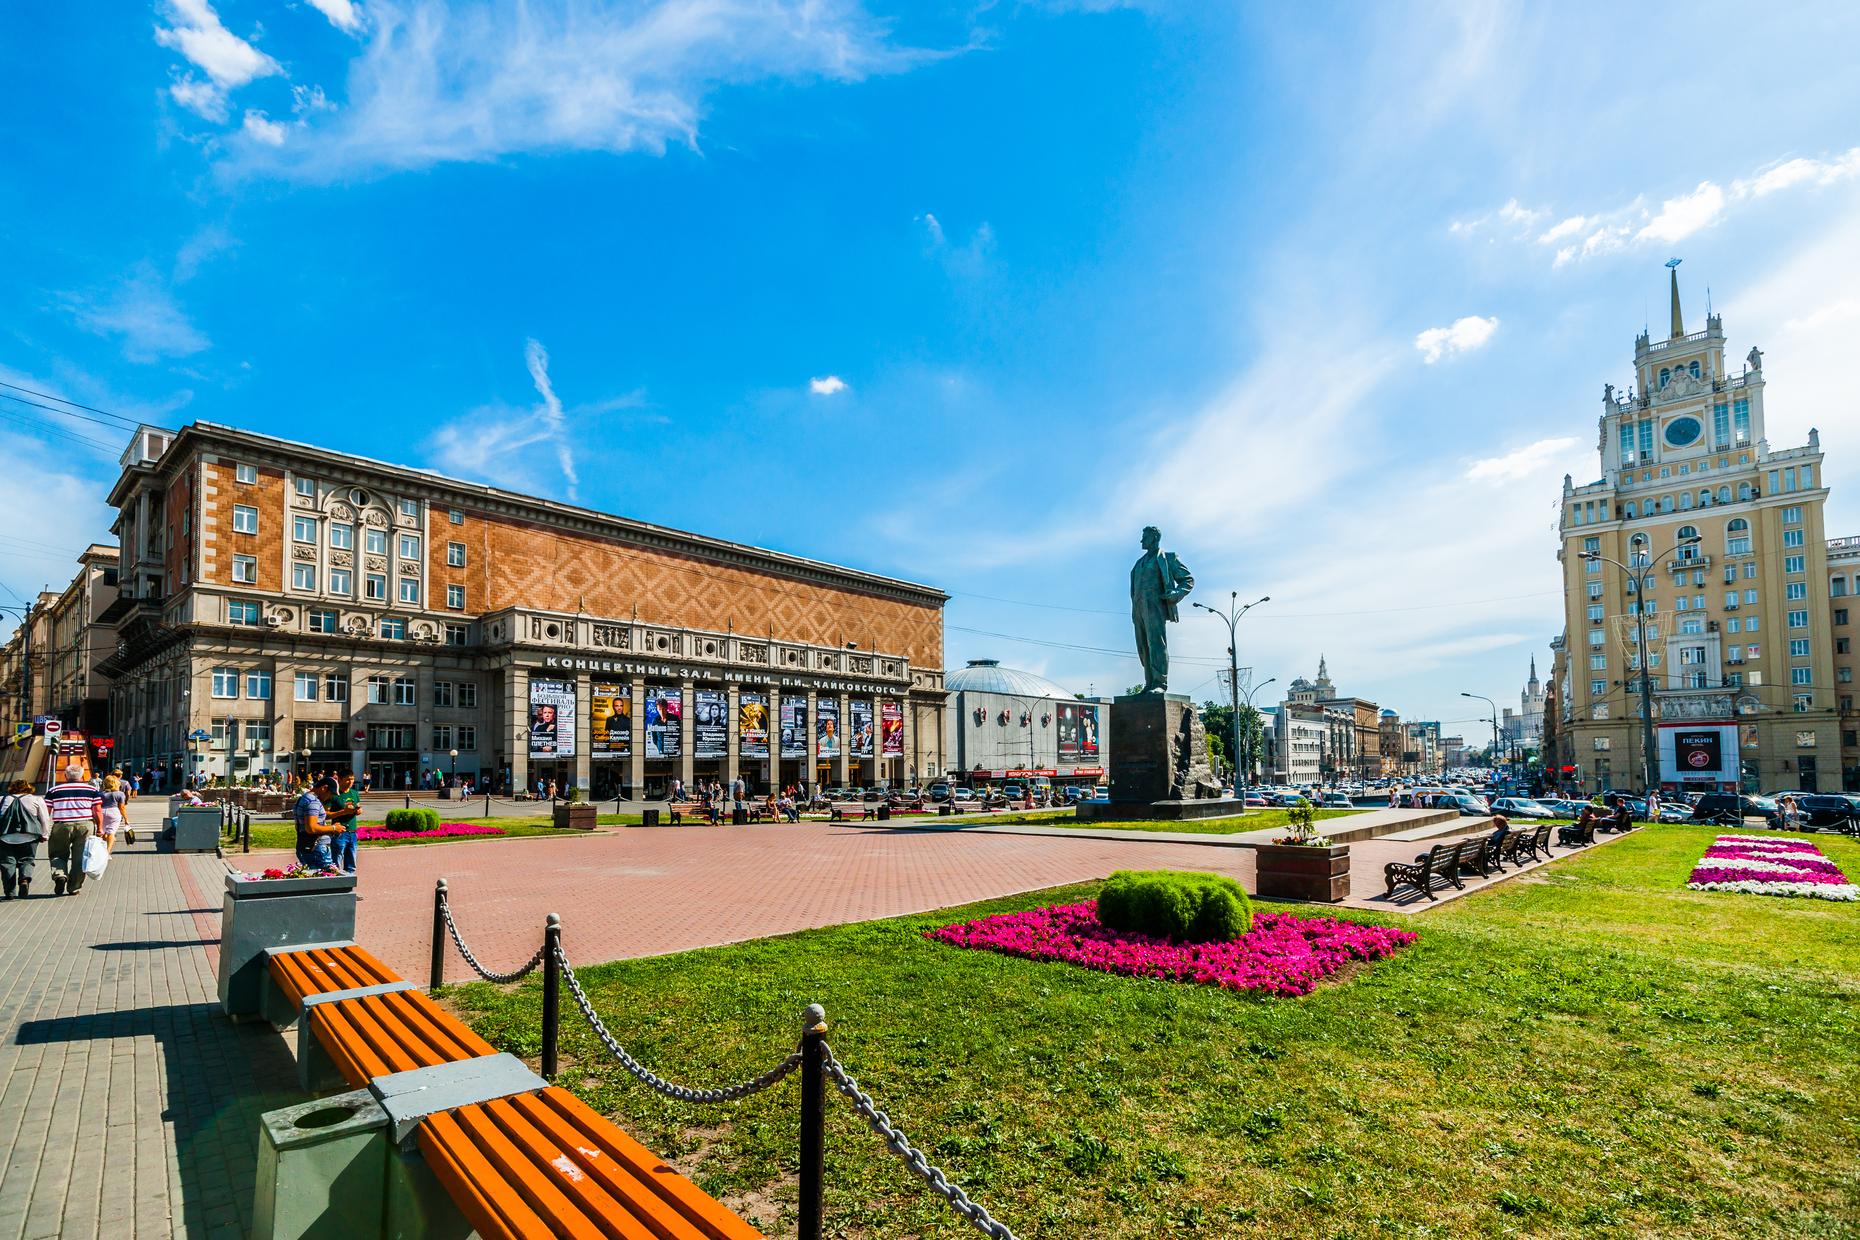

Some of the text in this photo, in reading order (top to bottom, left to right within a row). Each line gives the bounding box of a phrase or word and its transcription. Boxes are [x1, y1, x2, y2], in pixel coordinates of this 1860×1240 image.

[546, 656, 671, 675] КОНЦЕРТНЫЙ
[679, 668, 711, 679] ЗАЛ
[724, 673, 771, 684] ИМЕНИ
[813, 680, 896, 693] ЧАЙКОВСКОГО
